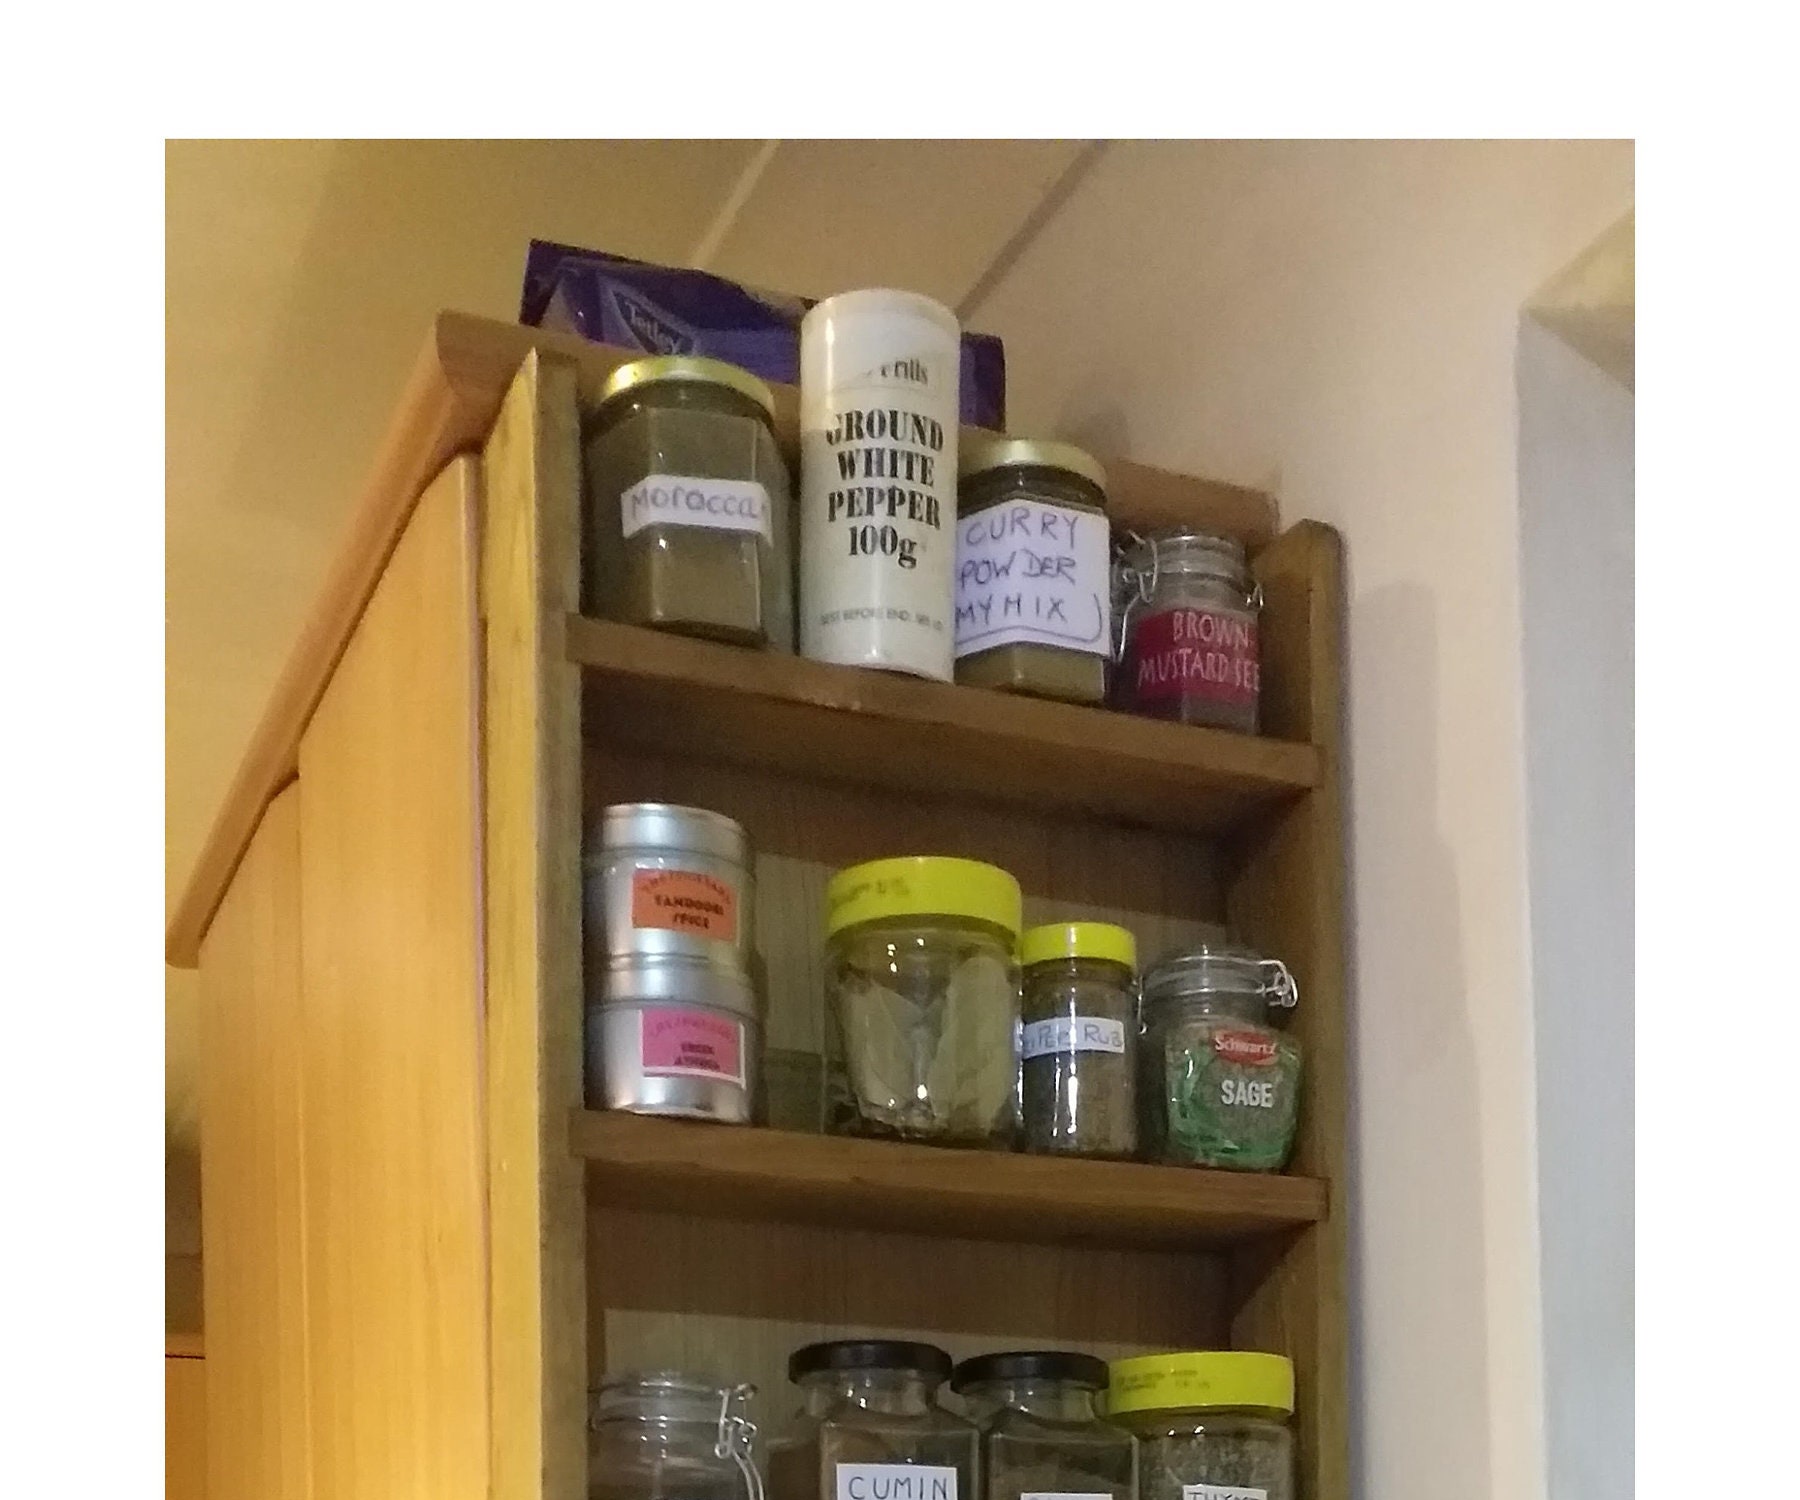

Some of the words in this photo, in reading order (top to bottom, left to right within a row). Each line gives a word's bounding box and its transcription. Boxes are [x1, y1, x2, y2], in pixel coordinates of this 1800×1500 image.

[826, 408, 944, 451] GROUND
[837, 447, 935, 487] WHITE
[827, 485, 941, 530] PEPPER
[966, 506, 1079, 549] CURRY
[849, 524, 918, 569] 100g
[1172, 610, 1250, 650] BROWN
[1137, 648, 1230, 689] MUSTARD
[1234, 657, 1260, 692] SEE
[1221, 1079, 1275, 1109] SAGE
